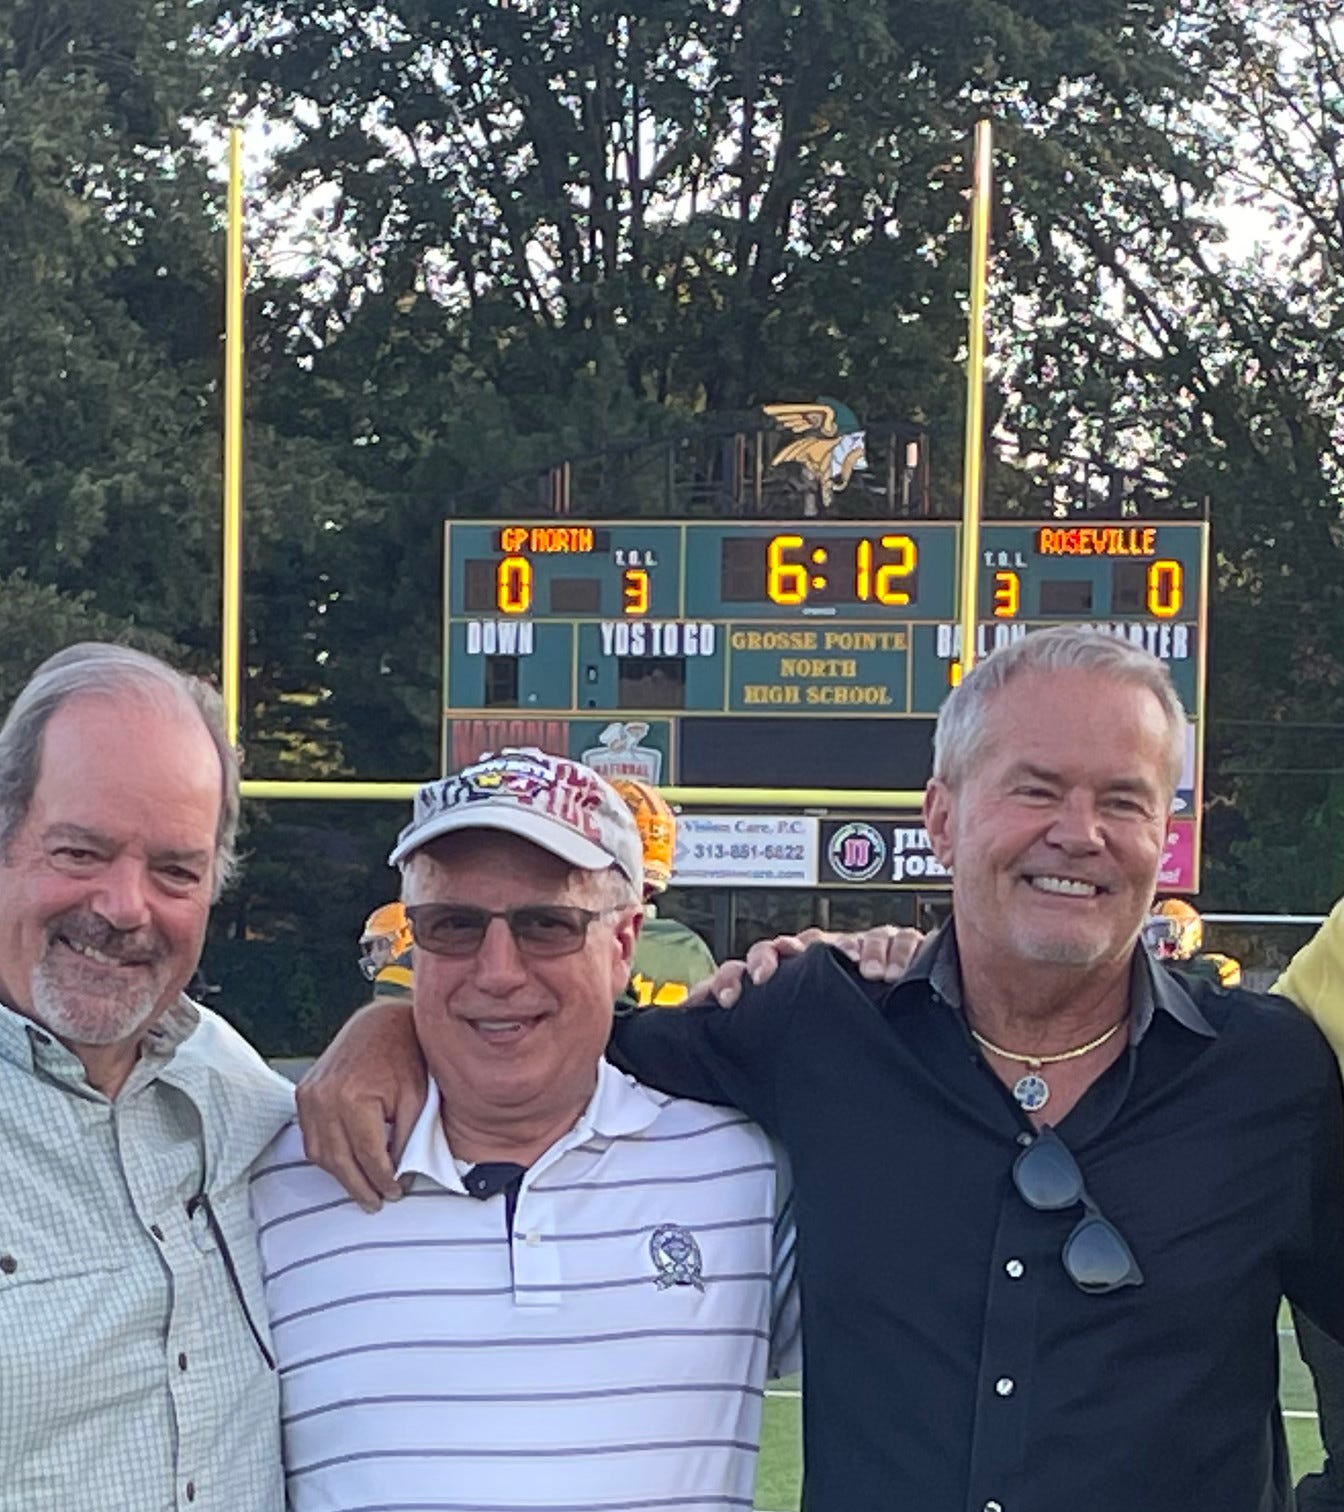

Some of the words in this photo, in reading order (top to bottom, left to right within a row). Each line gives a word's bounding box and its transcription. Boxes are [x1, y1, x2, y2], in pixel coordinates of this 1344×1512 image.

[501, 528, 528, 552] GP
[530, 528, 593, 552] NORTH
[1040, 528, 1156, 554] ROSEVILLE
[497, 556, 532, 614] 0
[767, 535, 917, 604] 6:12
[623, 569, 649, 614] 3
[993, 570, 1019, 617] 3
[1147, 560, 1182, 617] 0
[467, 622, 533, 655] DOWN
[601, 622, 646, 656] YDS
[651, 623, 679, 656] TO
[683, 623, 715, 656] GO
[731, 632, 817, 650] GROSSE
[825, 632, 907, 650] POINTE
[937, 624, 987, 658] BAL
[780, 658, 856, 677] NORTH
[744, 685, 800, 704] HIGH
[807, 686, 892, 705] SCHOOL
